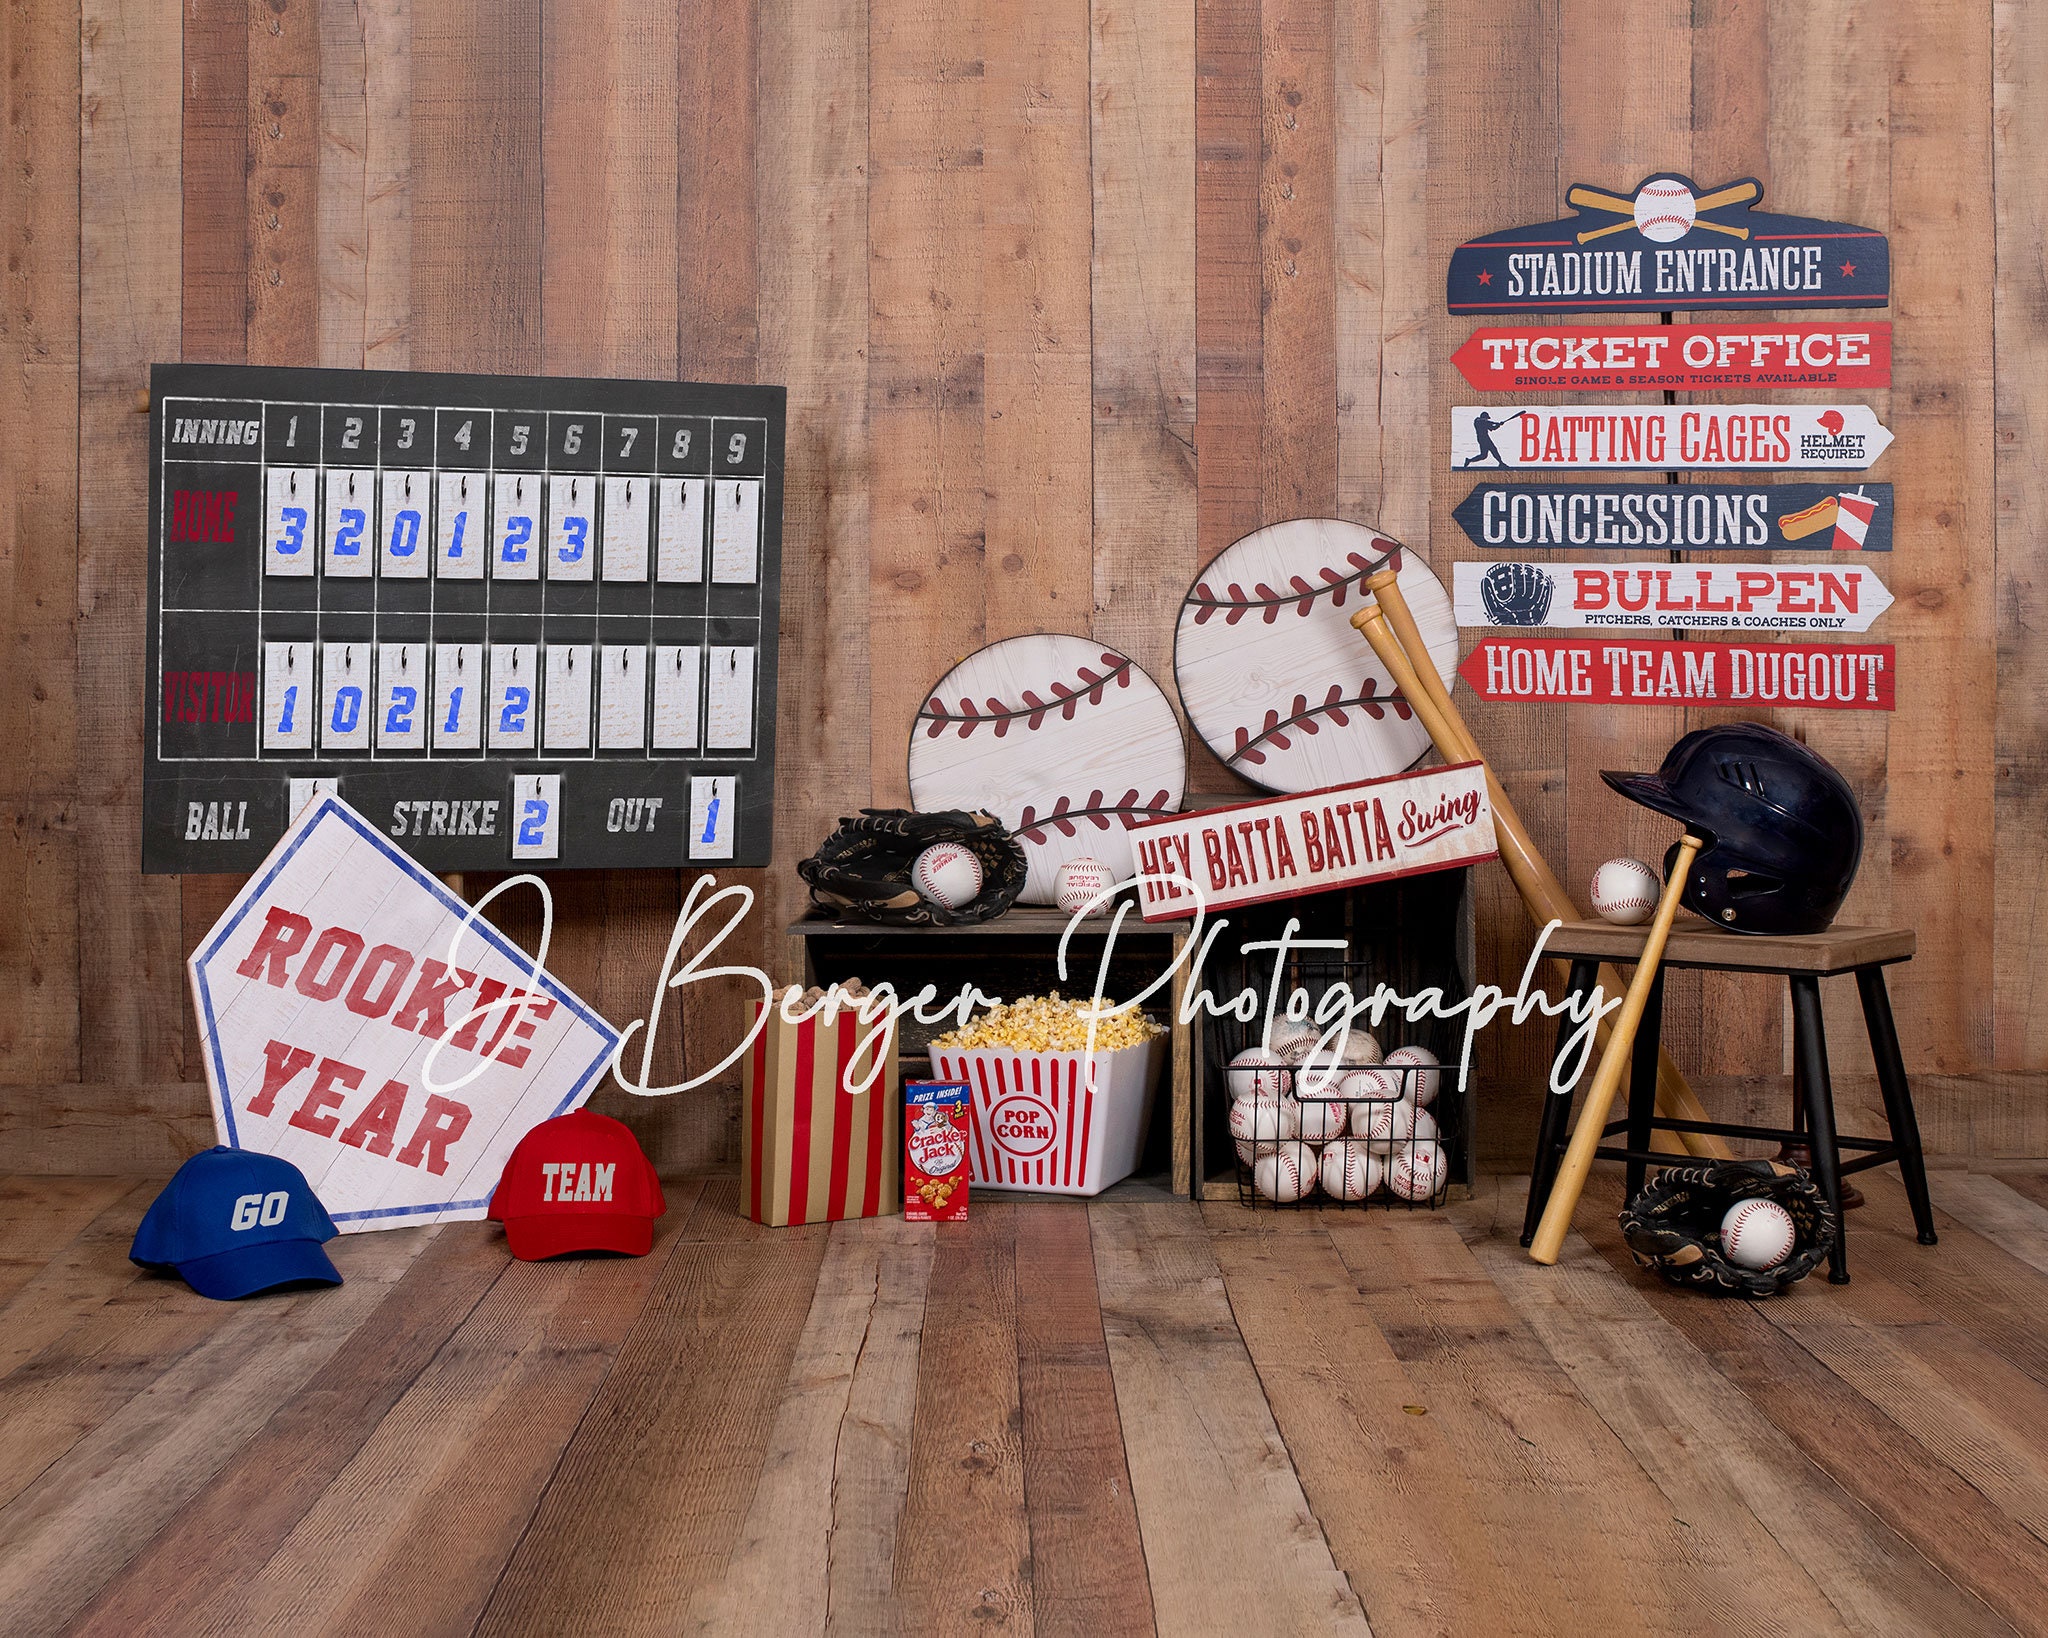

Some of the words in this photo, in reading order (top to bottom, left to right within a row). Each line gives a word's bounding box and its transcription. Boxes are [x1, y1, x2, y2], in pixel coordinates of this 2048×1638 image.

[1508, 251, 1642, 297] STADIUM
[1655, 246, 1822, 293] ENTRANCE
[1482, 336, 1669, 370] TICKET
[1682, 333, 1871, 368] OFFICE
[1515, 375, 1568, 386] SINGLE
[1571, 375, 1612, 385] GAME
[1615, 375, 1625, 385] &
[1628, 374, 1685, 385] SEASON
[1689, 373, 1751, 384] TICKETS
[1756, 372, 1838, 384] AVAILABLE
[172, 418, 260, 446] INNING
[286, 416, 298, 447] 1
[341, 417, 364, 449] 2
[396, 418, 416, 449] 3
[453, 420, 472, 451] 4
[510, 425, 530, 455] 5
[563, 424, 584, 454] 6
[620, 427, 639, 457] 7
[672, 429, 691, 459] 8
[728, 432, 747, 464] 9
[1519, 412, 1666, 463] BATTING
[1680, 412, 1791, 463] CAGES
[1800, 434, 1866, 448] HELMET
[1800, 448, 1866, 460] REQUIRED
[170, 489, 239, 543] HOME
[275, 507, 308, 555] 3
[333, 508, 366, 556] 2
[389, 510, 422, 557] 0
[447, 511, 468, 558] 1
[500, 516, 533, 562] 2
[557, 516, 589, 562] 3
[1482, 491, 1769, 546] CONCESSIONS
[1572, 570, 1863, 614] BULLPEN
[1585, 615, 1653, 626] PITCHERS,
[1658, 615, 1728, 627] CATCHERS
[1731, 616, 1741, 627] &
[1744, 616, 1807, 628] COACHES
[1810, 617, 1846, 629] ONLY
[1484, 645, 1593, 696] HOME
[1603, 647, 1717, 699] TEAM
[1729, 649, 1885, 702] DUGOUT
[163, 671, 257, 723] VISITOR
[277, 685, 298, 733] 1
[330, 686, 363, 733] 0
[385, 686, 418, 733] 2
[443, 686, 464, 733] 1
[499, 686, 531, 733] 2
[184, 801, 252, 840] BALL
[390, 800, 499, 838] STRIKE
[517, 799, 550, 846] 2
[606, 797, 664, 832] OUT
[700, 798, 722, 844] 1
[1138, 832, 1195, 903] HEY
[1203, 815, 1298, 891] BATTA
[1300, 797, 1396, 873] BATTA
[235, 905, 559, 1069] ROOKIE
[246, 1039, 473, 1177] YEAR
[913, 1092, 935, 1103] PRIZE
[936, 1086, 962, 1099] INSIDE!
[955, 1100, 962, 1112] 3
[996, 1125, 1050, 1140] CORN
[1004, 1110, 1040, 1124] POP
[909, 1129, 967, 1150] Cracker
[919, 1142, 956, 1163] Jack
[542, 1162, 616, 1202] TEAM
[230, 1190, 289, 1232] GO
